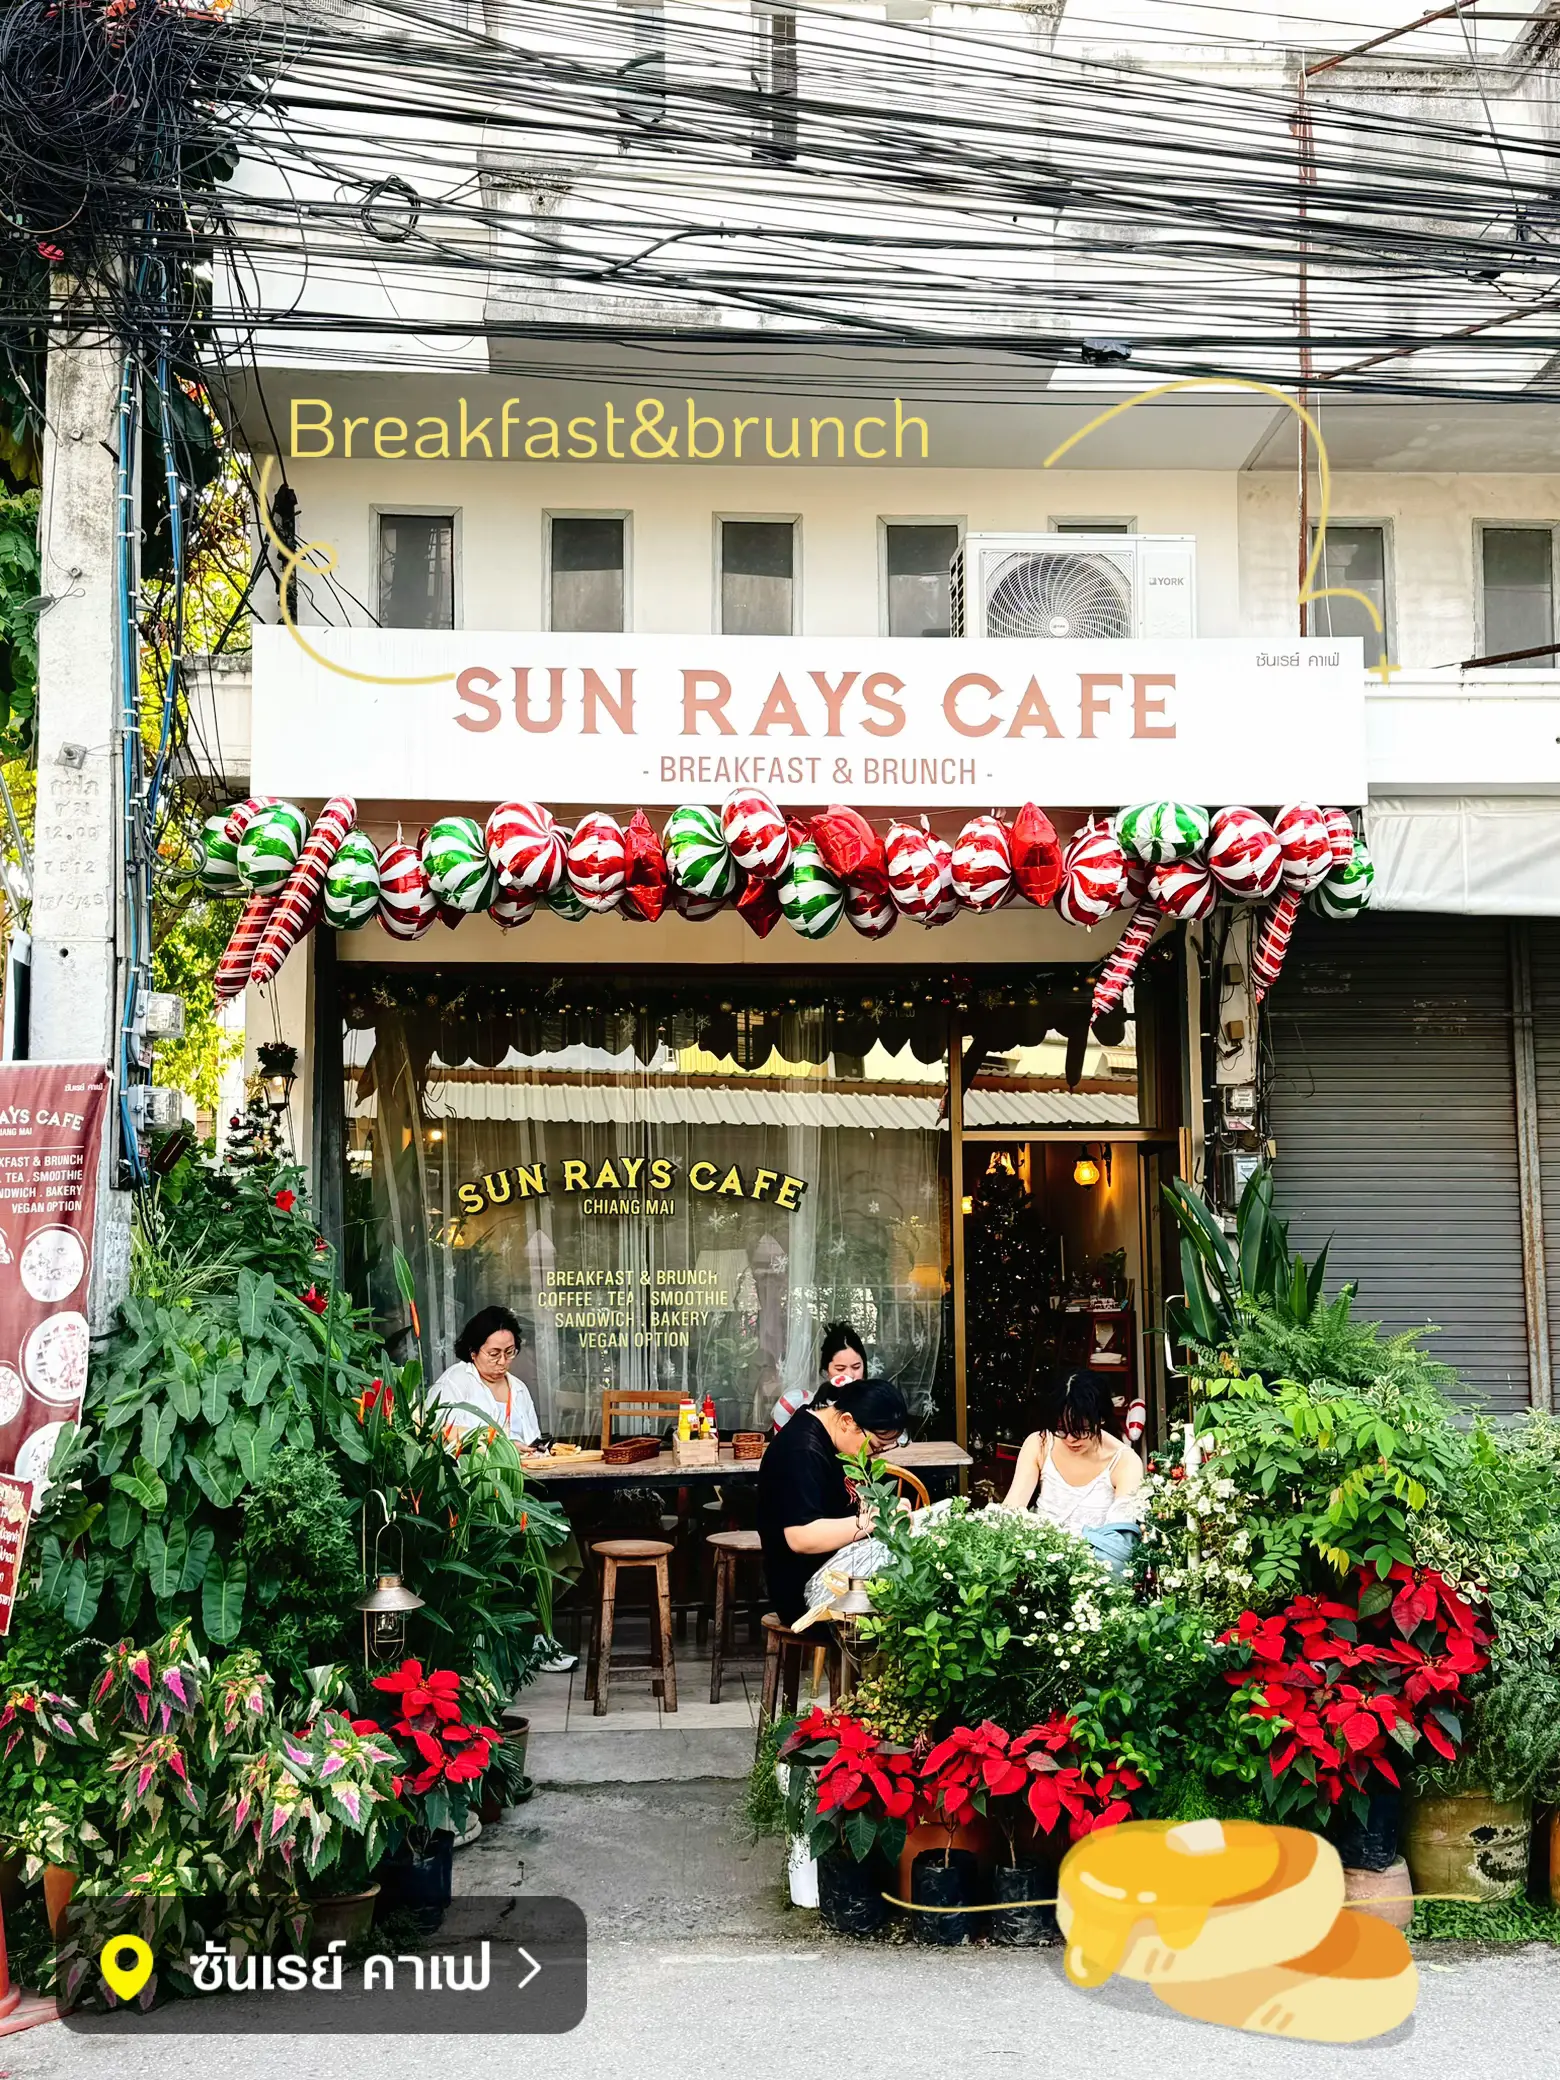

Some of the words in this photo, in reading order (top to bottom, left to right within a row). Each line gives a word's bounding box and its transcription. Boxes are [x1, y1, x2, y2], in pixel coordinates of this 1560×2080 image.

[1158, 577, 1184, 586] YORK
[452, 666, 638, 735] SUN
[678, 669, 907, 738] RAYS
[940, 672, 1176, 739] CAFE
[660, 755, 822, 784] BREAKFAST
[832, 757, 853, 785] &
[864, 757, 976, 785] BRUNCH
[0, 1105, 31, 1124] AYS
[36, 1109, 84, 1131] CAFE
[0, 1127, 17, 1136] IANG
[19, 1127, 33, 1136] MAI
[0, 1156, 30, 1168] KFAST
[32, 1155, 42, 1167] &
[44, 1154, 84, 1167] BRUNCH
[5, 1172, 24, 1183] TEA
[33, 1169, 83, 1182] SMOOTHIE
[0, 1187, 36, 1199] NDWICH
[45, 1185, 83, 1197] BAKERY
[457, 1161, 549, 1215] SUN
[561, 1156, 678, 1192] RAYS
[688, 1160, 808, 1212] CAFE
[12, 1202, 45, 1214] VEGAN
[46, 1200, 82, 1213] OPTION
[583, 1199, 641, 1216] CHIANG
[645, 1199, 675, 1216] MAI
[546, 1270, 635, 1287] BREAKFAST
[639, 1270, 652, 1286] &
[656, 1269, 718, 1286] BRUNCH
[537, 1291, 593, 1308] COFFEE
[607, 1290, 635, 1306] TEA
[650, 1289, 729, 1306] SMOOTHIE
[554, 1312, 636, 1328] SANDWICH
[650, 1311, 709, 1327] BAKERY
[578, 1332, 629, 1349] VEGAN
[634, 1331, 690, 1348] OPTION
